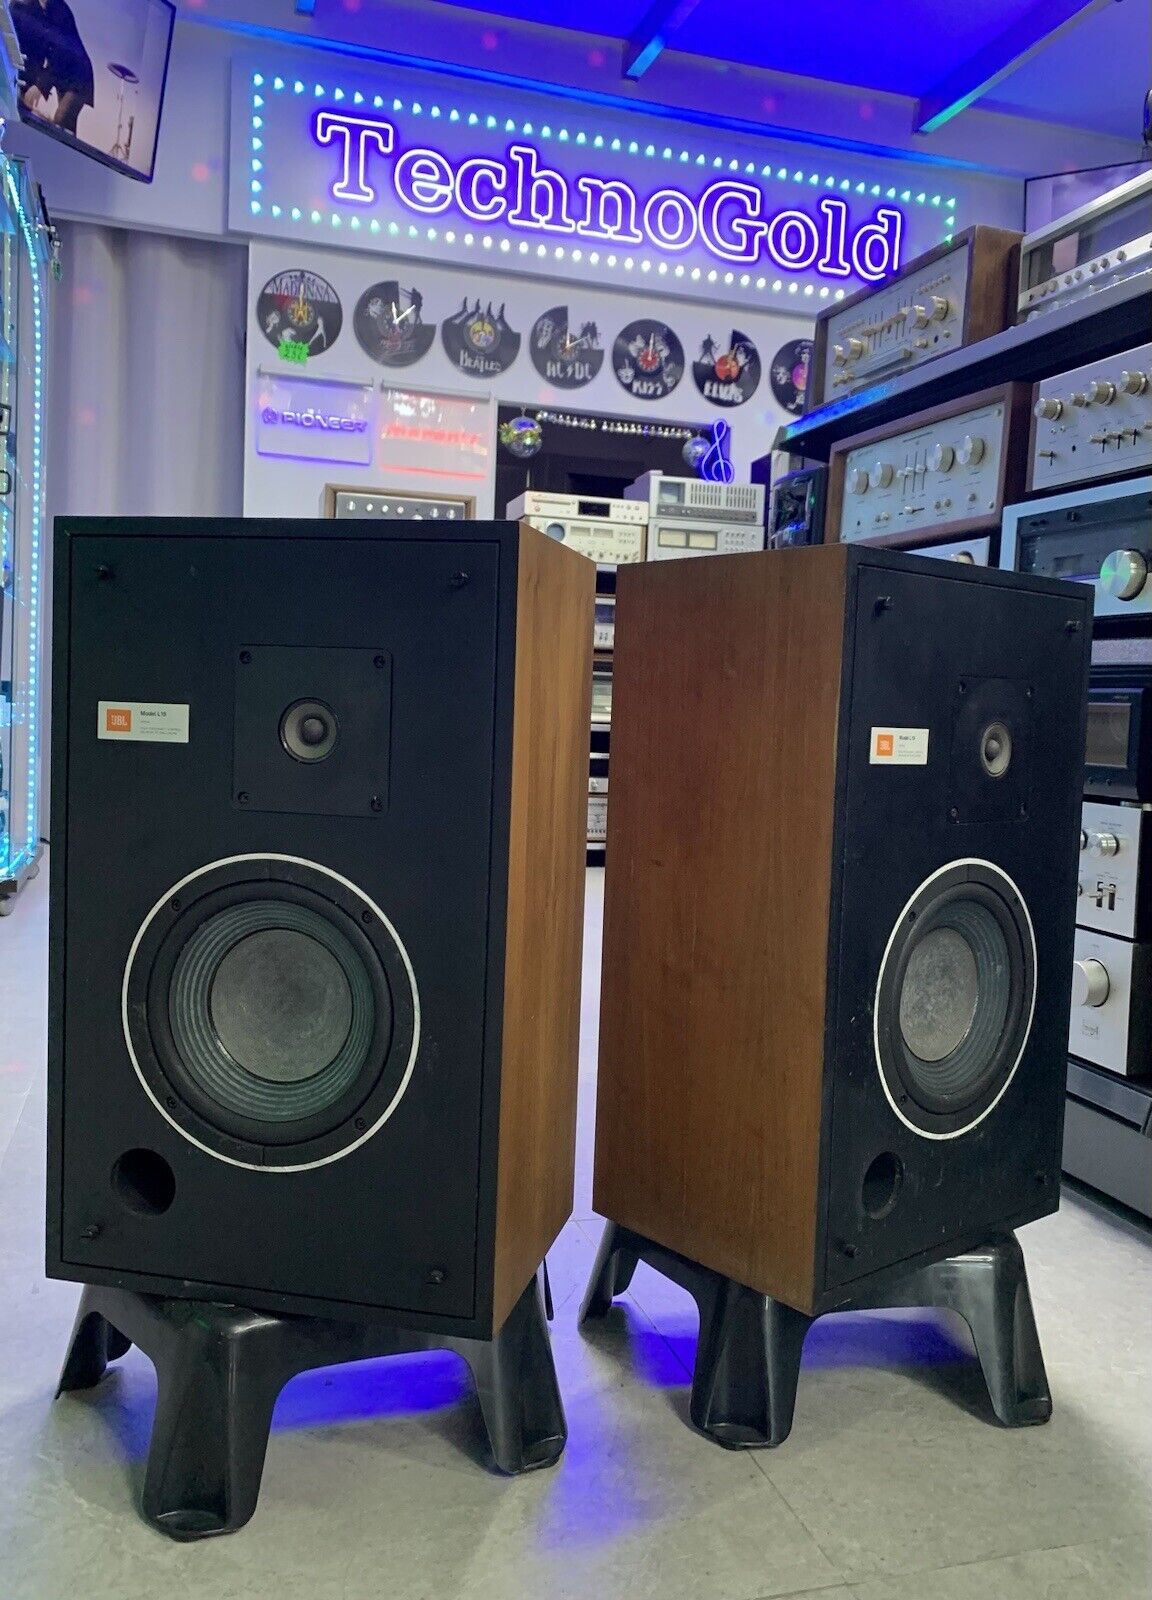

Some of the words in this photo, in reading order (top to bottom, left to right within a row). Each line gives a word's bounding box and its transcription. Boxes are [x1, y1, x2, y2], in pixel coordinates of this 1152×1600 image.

[314, 111, 904, 282] TechnoGold
[281, 410, 369, 433] PIONEER
[111, 714, 128, 726] JBL
